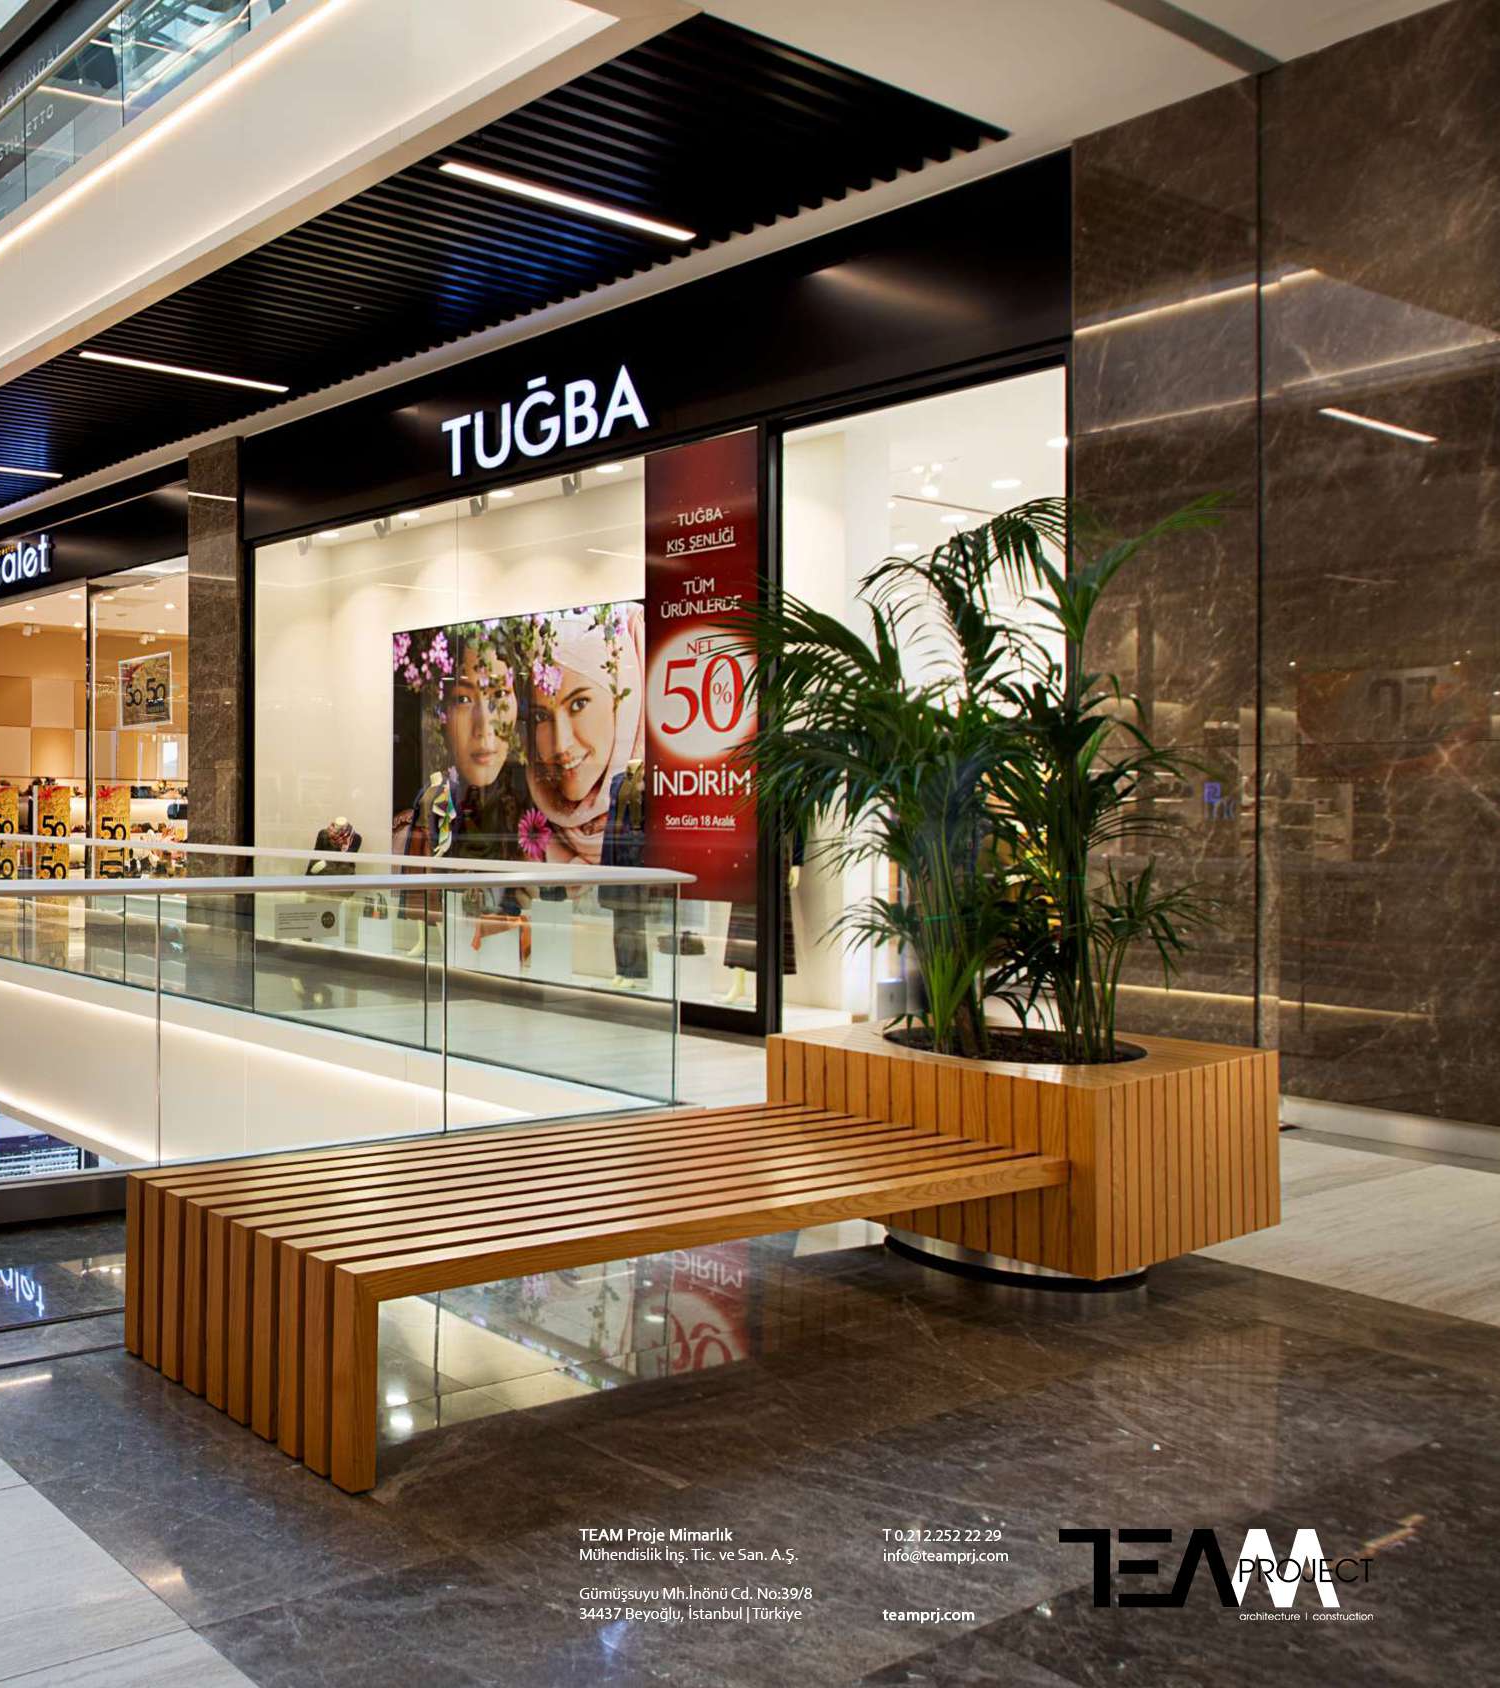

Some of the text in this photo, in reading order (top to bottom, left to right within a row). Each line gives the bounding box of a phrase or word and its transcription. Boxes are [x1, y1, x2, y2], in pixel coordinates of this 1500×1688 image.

[441, 365, 649, 477] TUĞBA
[666, 526, 735, 553] KIŞ ŞENLİĞİ
[683, 576, 715, 595] TÜM
[661, 594, 742, 618] ÜRÜNLERDE
[686, 639, 715, 655] NET
[146, 677, 166, 702] 50
[661, 653, 745, 735] 50
[653, 763, 751, 797] İNDİRİM
[42, 815, 67, 837] 50
[100, 816, 126, 840] 50
[665, 814, 680, 827] Son
[681, 814, 699, 828] Gün
[700, 815, 711, 827] 18
[40, 856, 66, 879] 50
